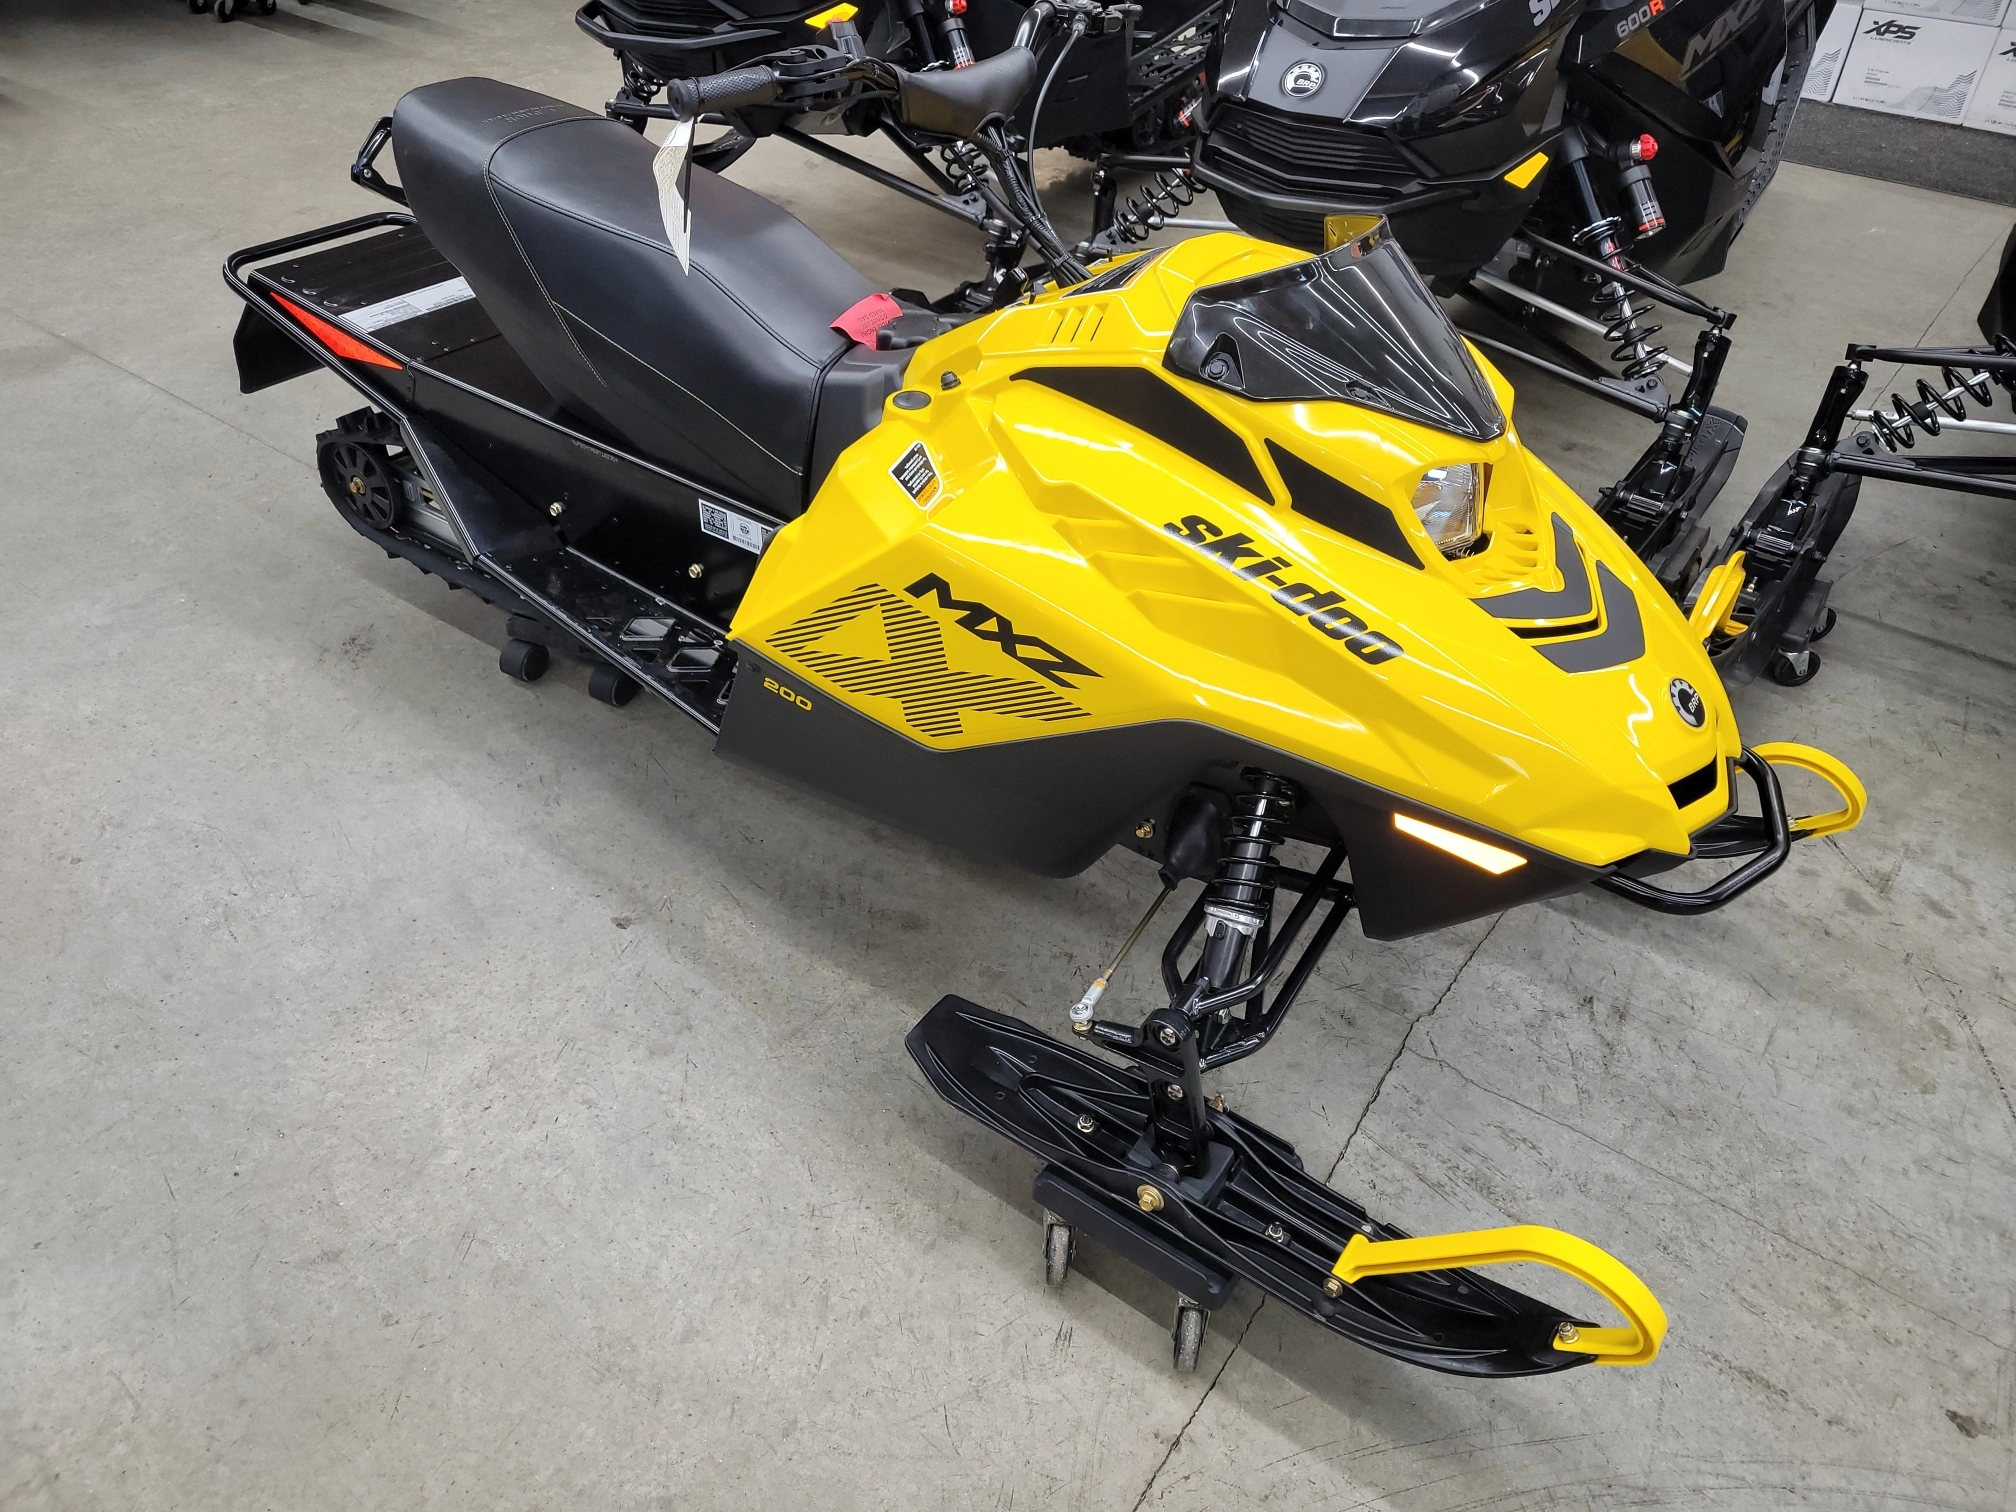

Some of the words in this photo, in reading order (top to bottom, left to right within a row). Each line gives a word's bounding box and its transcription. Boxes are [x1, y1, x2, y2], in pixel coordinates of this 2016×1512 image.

[1616, 0, 1665, 38] 600R
[1863, 19, 1922, 40] XPS
[1296, 78, 1317, 88] BRP
[1163, 514, 1405, 666] ski-doo
[902, 572, 1105, 690] MXZ
[763, 676, 813, 712] 200
[1688, 692, 1700, 713] BRP
